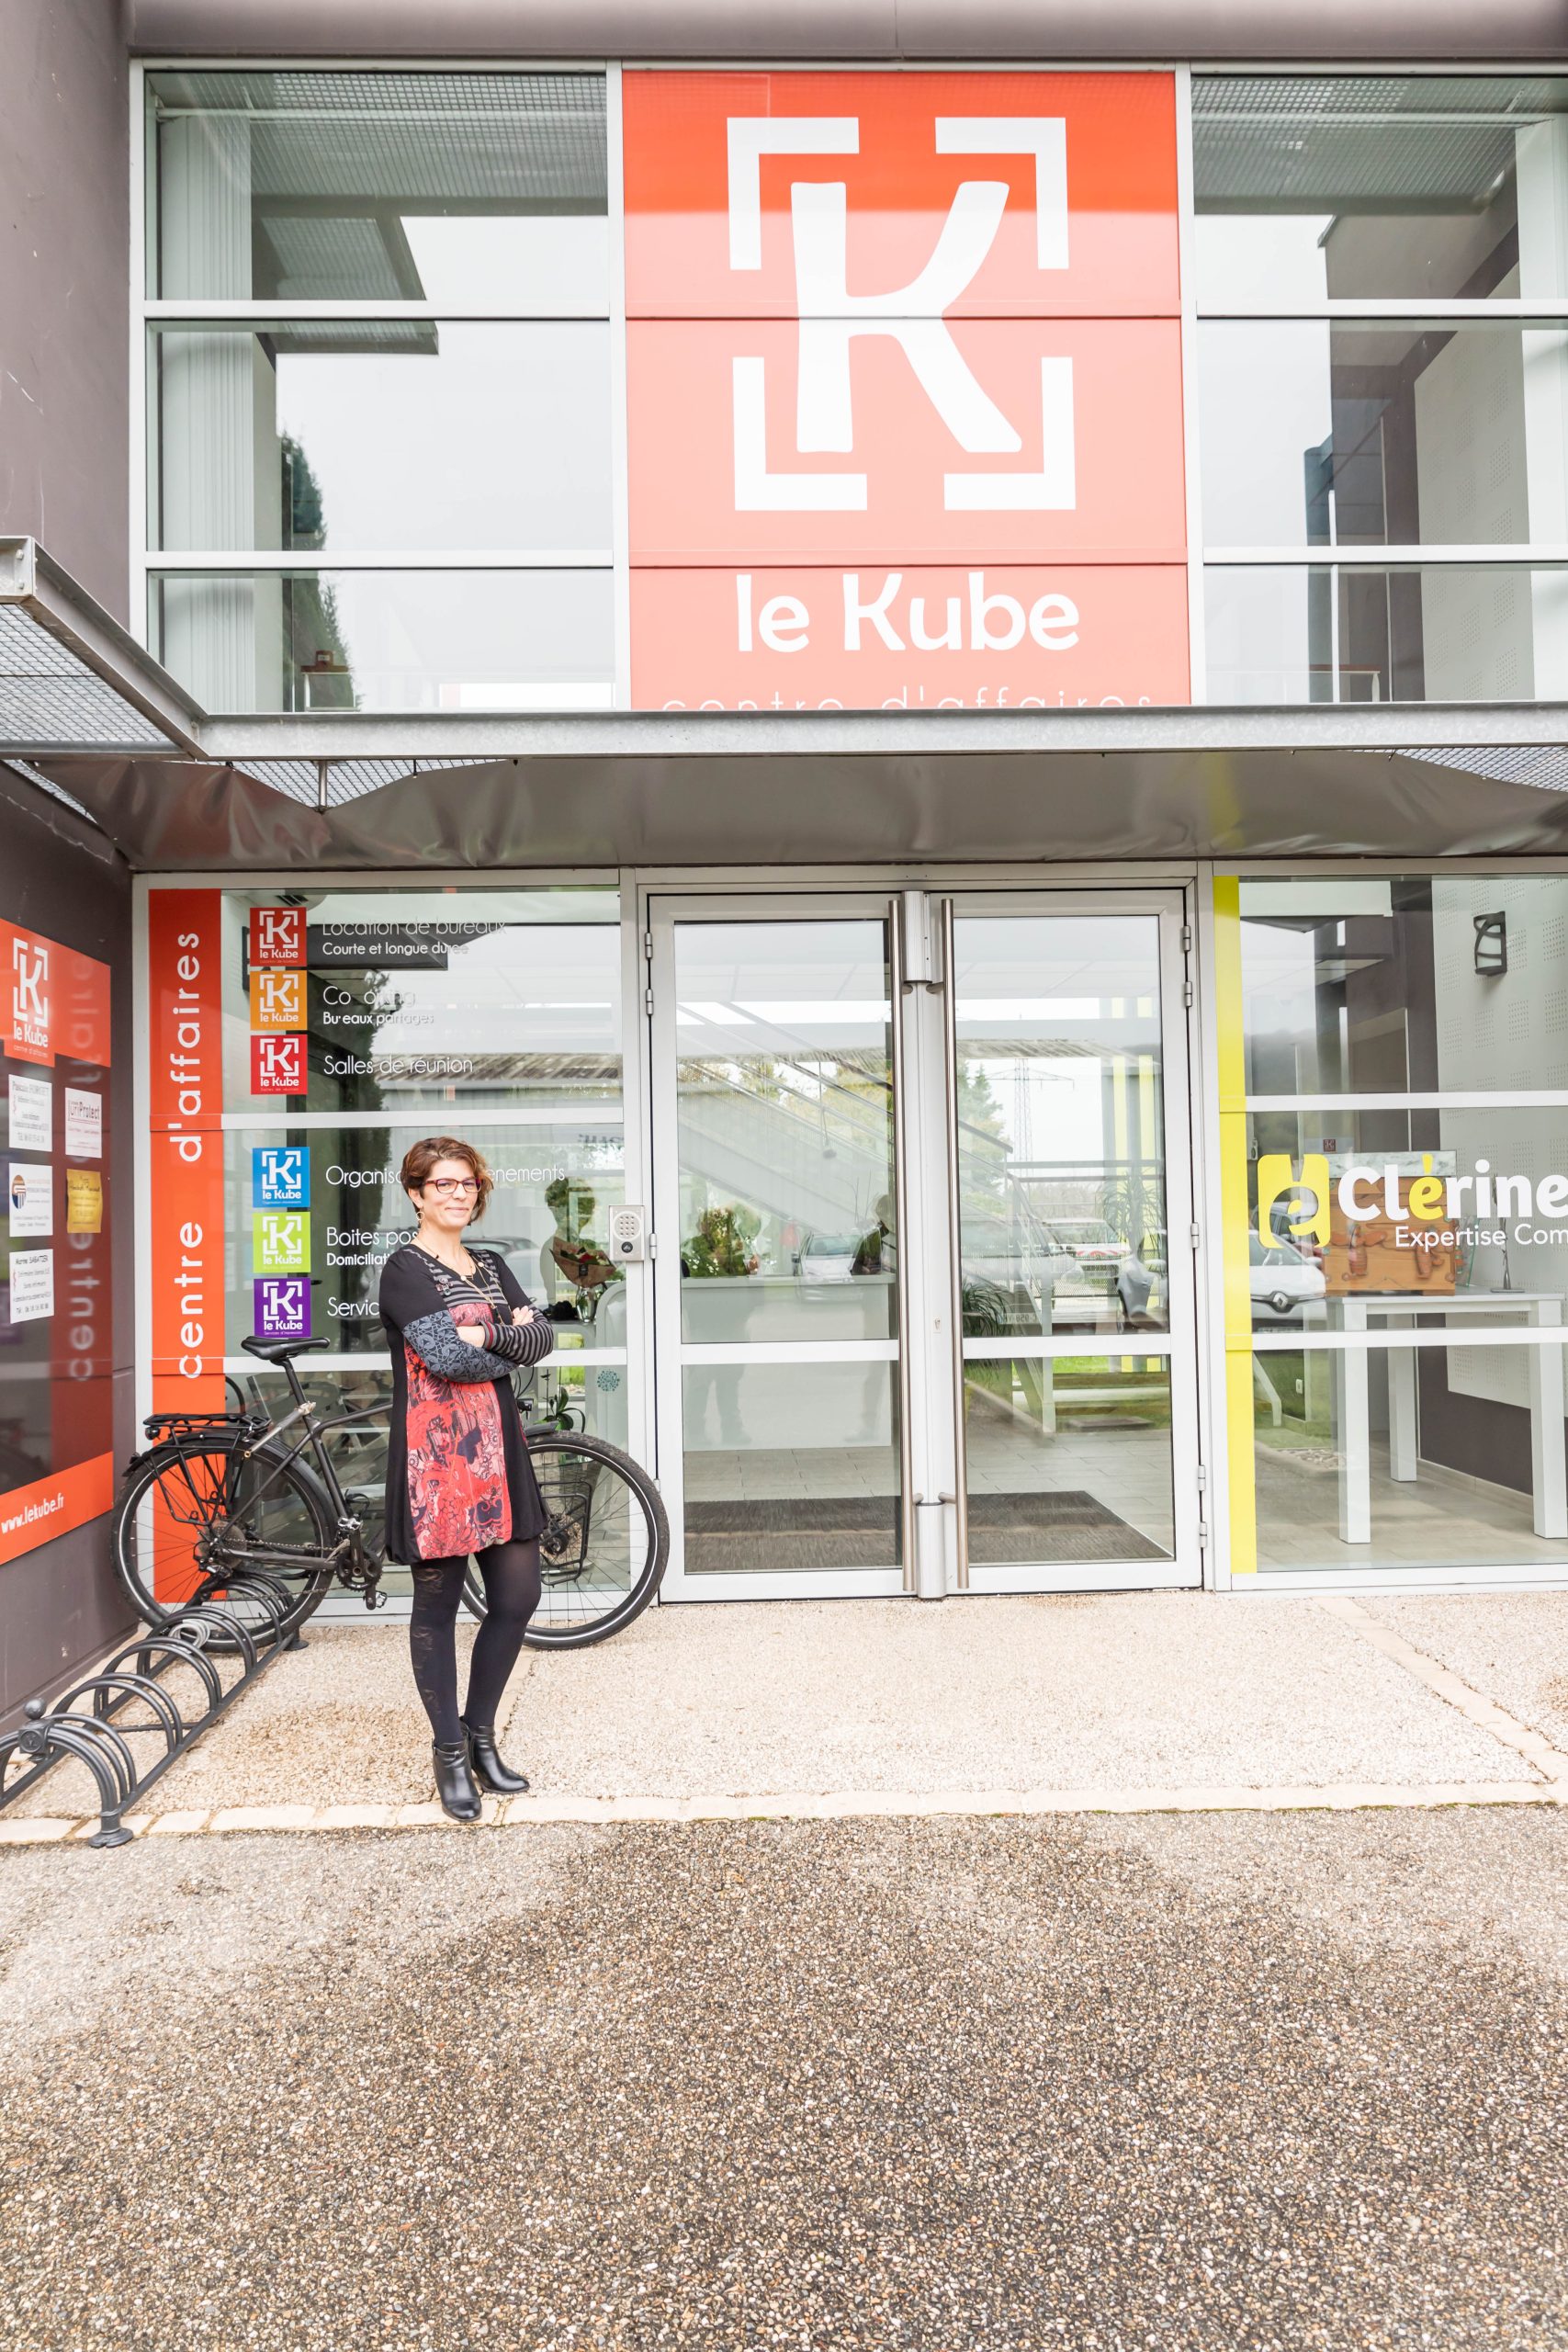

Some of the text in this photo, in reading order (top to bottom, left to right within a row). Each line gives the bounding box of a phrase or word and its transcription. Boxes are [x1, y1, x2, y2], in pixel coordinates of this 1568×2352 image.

[791, 180, 1022, 453] K
[736, 571, 1080, 652] le Kube
[322, 916, 507, 936] Location de bureaux
[259, 948, 299, 959] le Kube
[322, 942, 367, 956] Courte
[368, 943, 382, 955] et
[385, 941, 428, 956] longue
[259, 1012, 299, 1023] le Kube
[322, 1011, 373, 1025] Bueaux
[14, 1020, 49, 1048] le Kube
[323, 1054, 473, 1075] Salles de réunion
[260, 1077, 299, 1088] le Kube
[168, 933, 204, 1380] centre d'affaires
[262, 1189, 302, 1200] le Kube
[1337, 1153, 1568, 1221] Clérine
[326, 1227, 379, 1246] Boites
[1395, 1223, 1568, 1252] Expertise Com
[263, 1255, 303, 1265] le Kube
[327, 1296, 380, 1317] Servic
[264, 1320, 303, 1330] le Kube
[0, 1492, 65, 1534] www.lekube.fr
